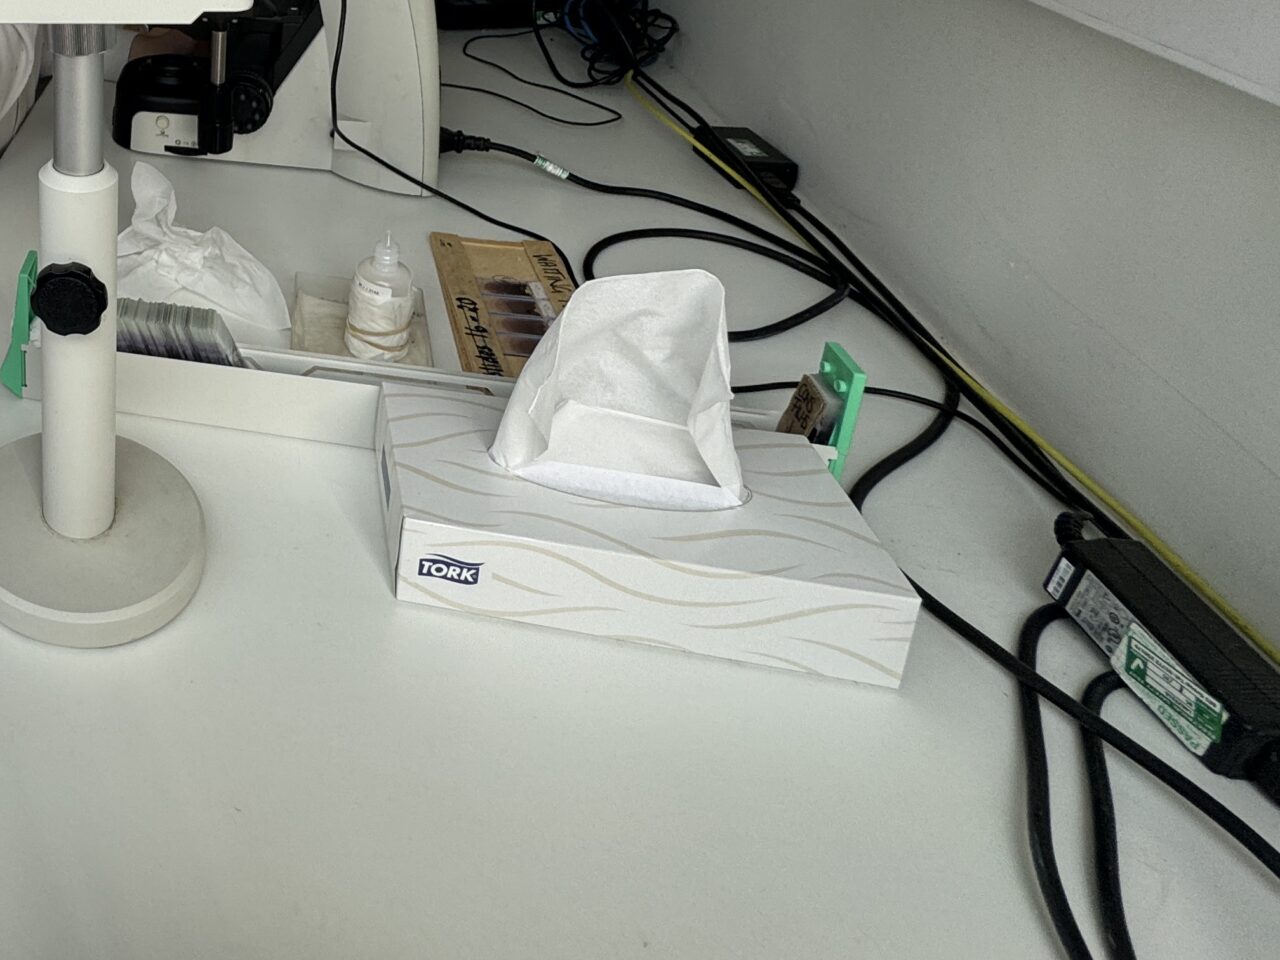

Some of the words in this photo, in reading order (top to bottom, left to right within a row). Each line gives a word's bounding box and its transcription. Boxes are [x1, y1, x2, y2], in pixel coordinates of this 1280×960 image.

[532, 253, 572, 295] WAITING
[421, 560, 478, 583] TORK
[1156, 704, 1201, 750] PASSED
